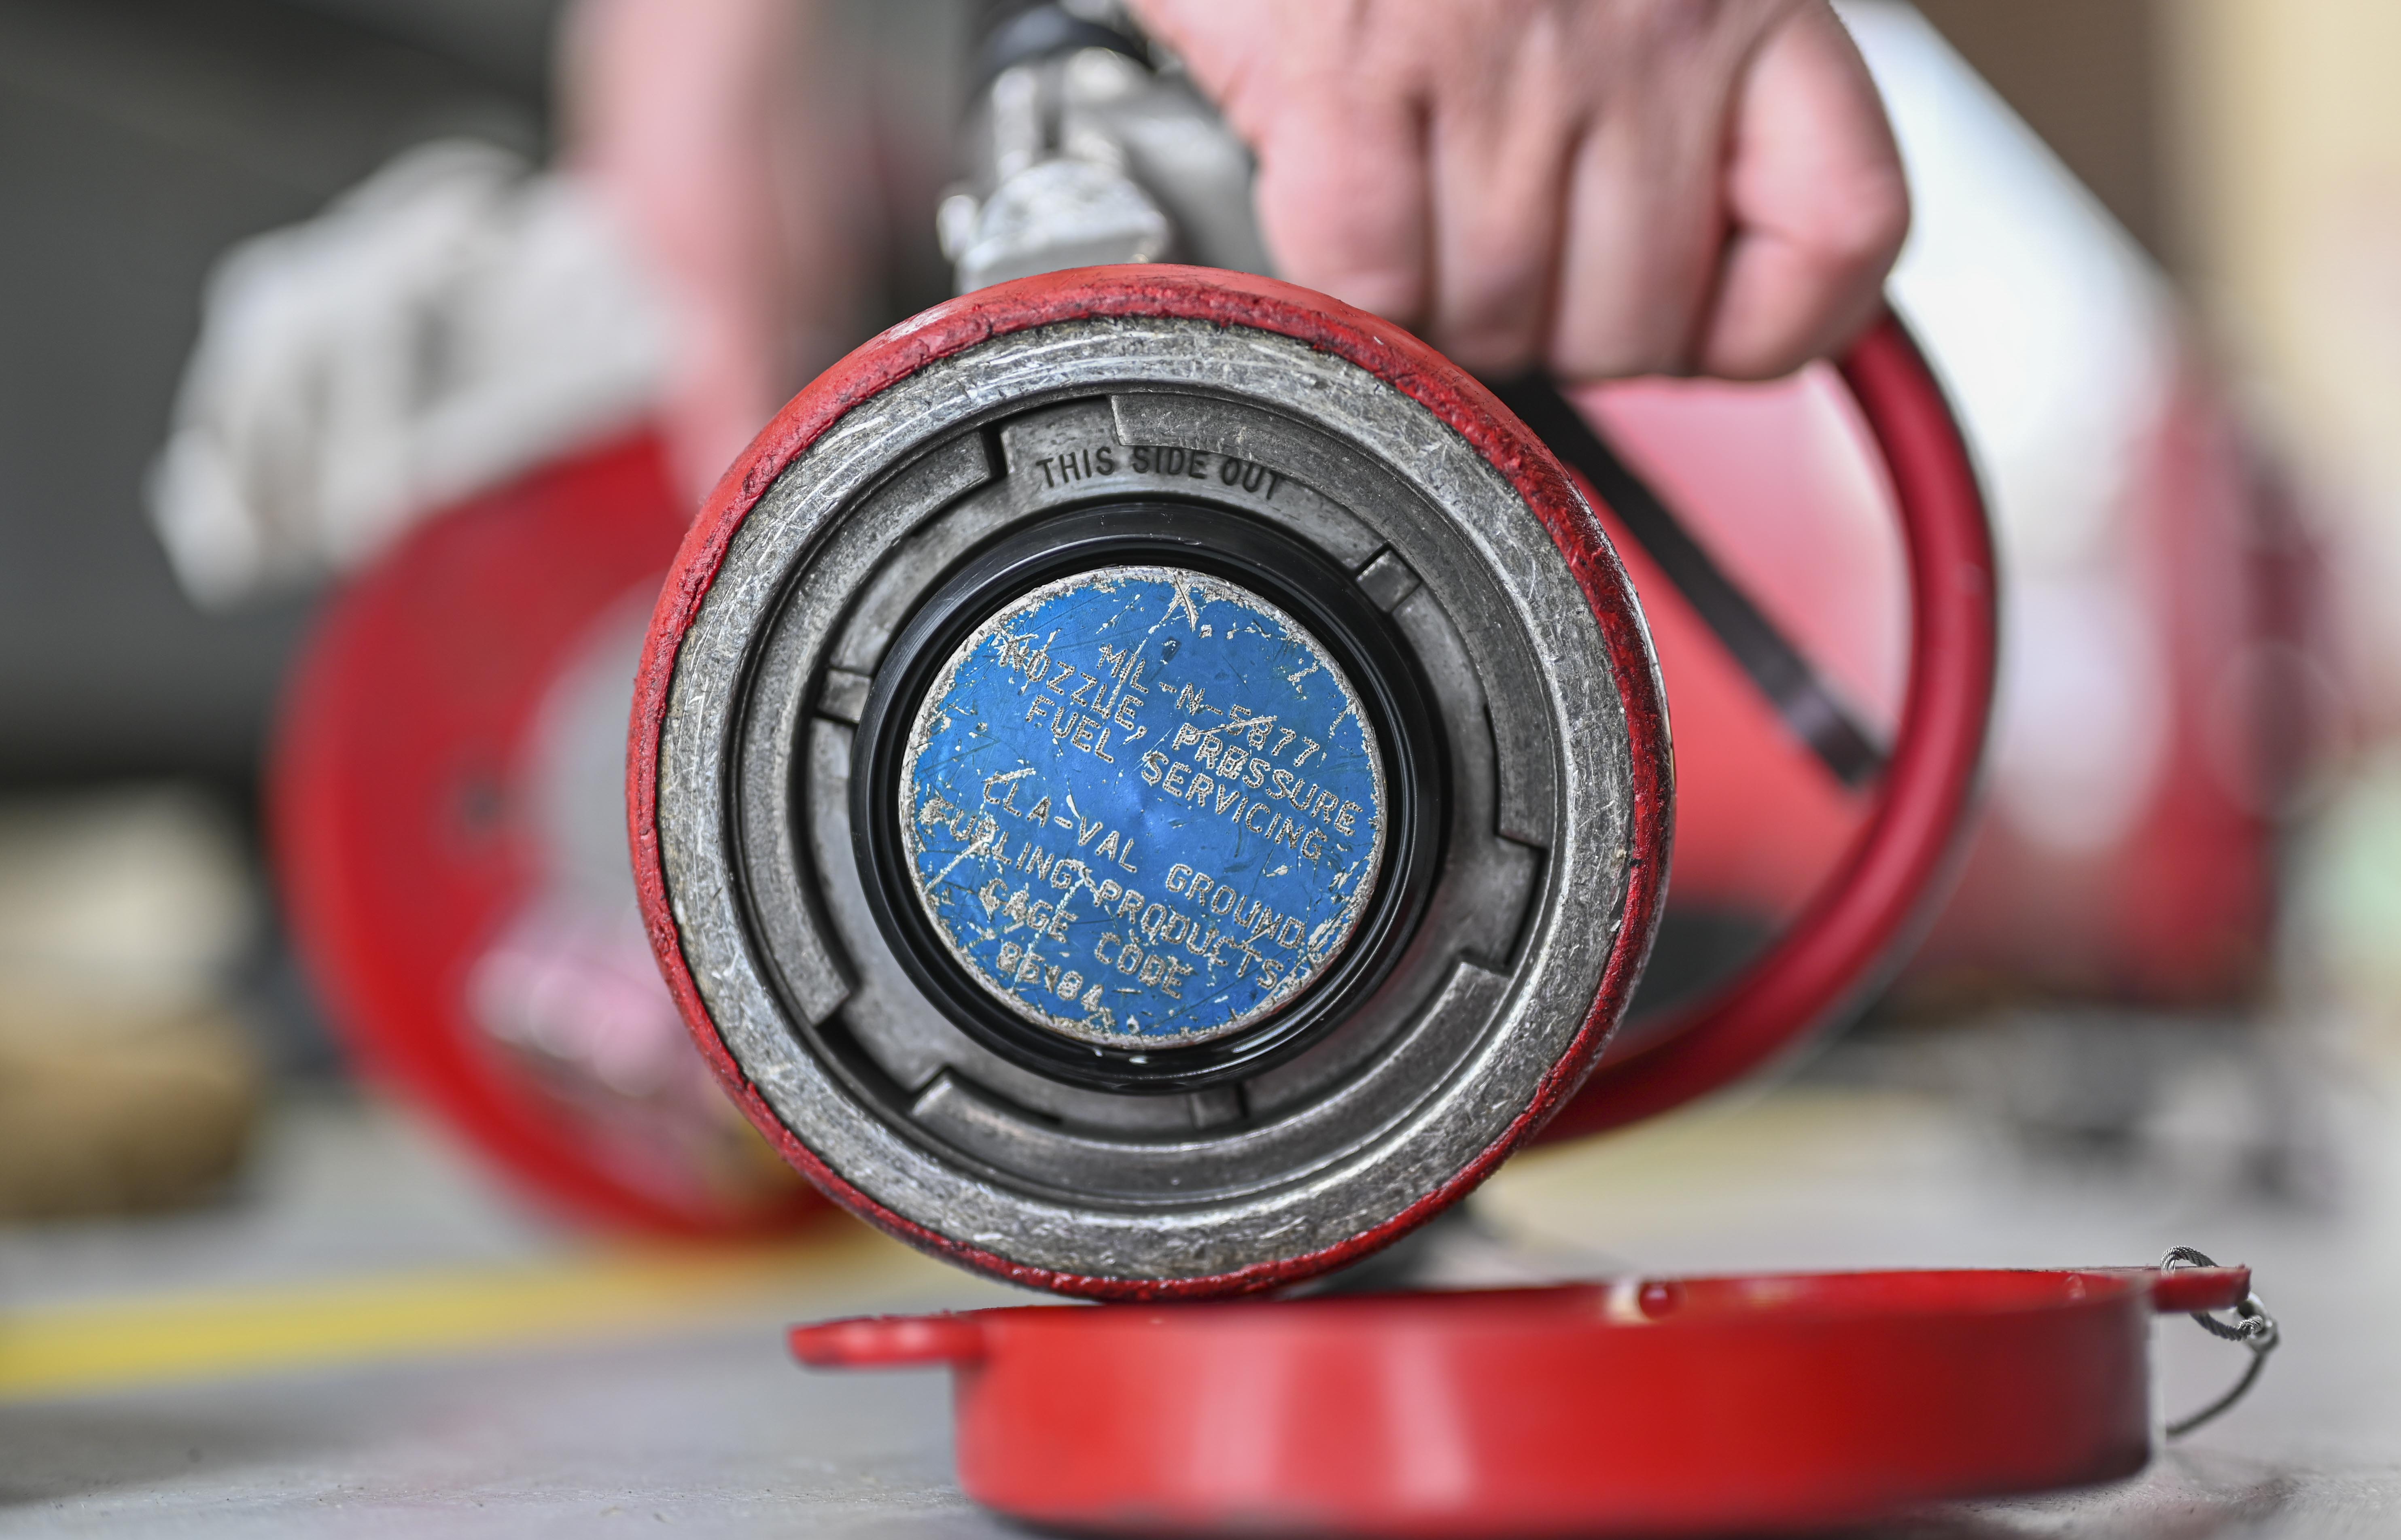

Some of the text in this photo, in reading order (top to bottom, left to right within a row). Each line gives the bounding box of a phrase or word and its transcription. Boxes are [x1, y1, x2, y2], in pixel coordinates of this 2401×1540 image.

[1036, 445, 1287, 500] THIS SIDE OUT
[1097, 643, 1320, 766] MIL-N-5877
[1025, 695, 1328, 859] FUEL SERVICING
[1172, 723, 1363, 836] PRESSURE
[984, 772, 1306, 949] CLA-VAL GROUND
[978, 877, 1194, 999] CAGE CODE
[1093, 879, 1284, 990] PRODUCTS
